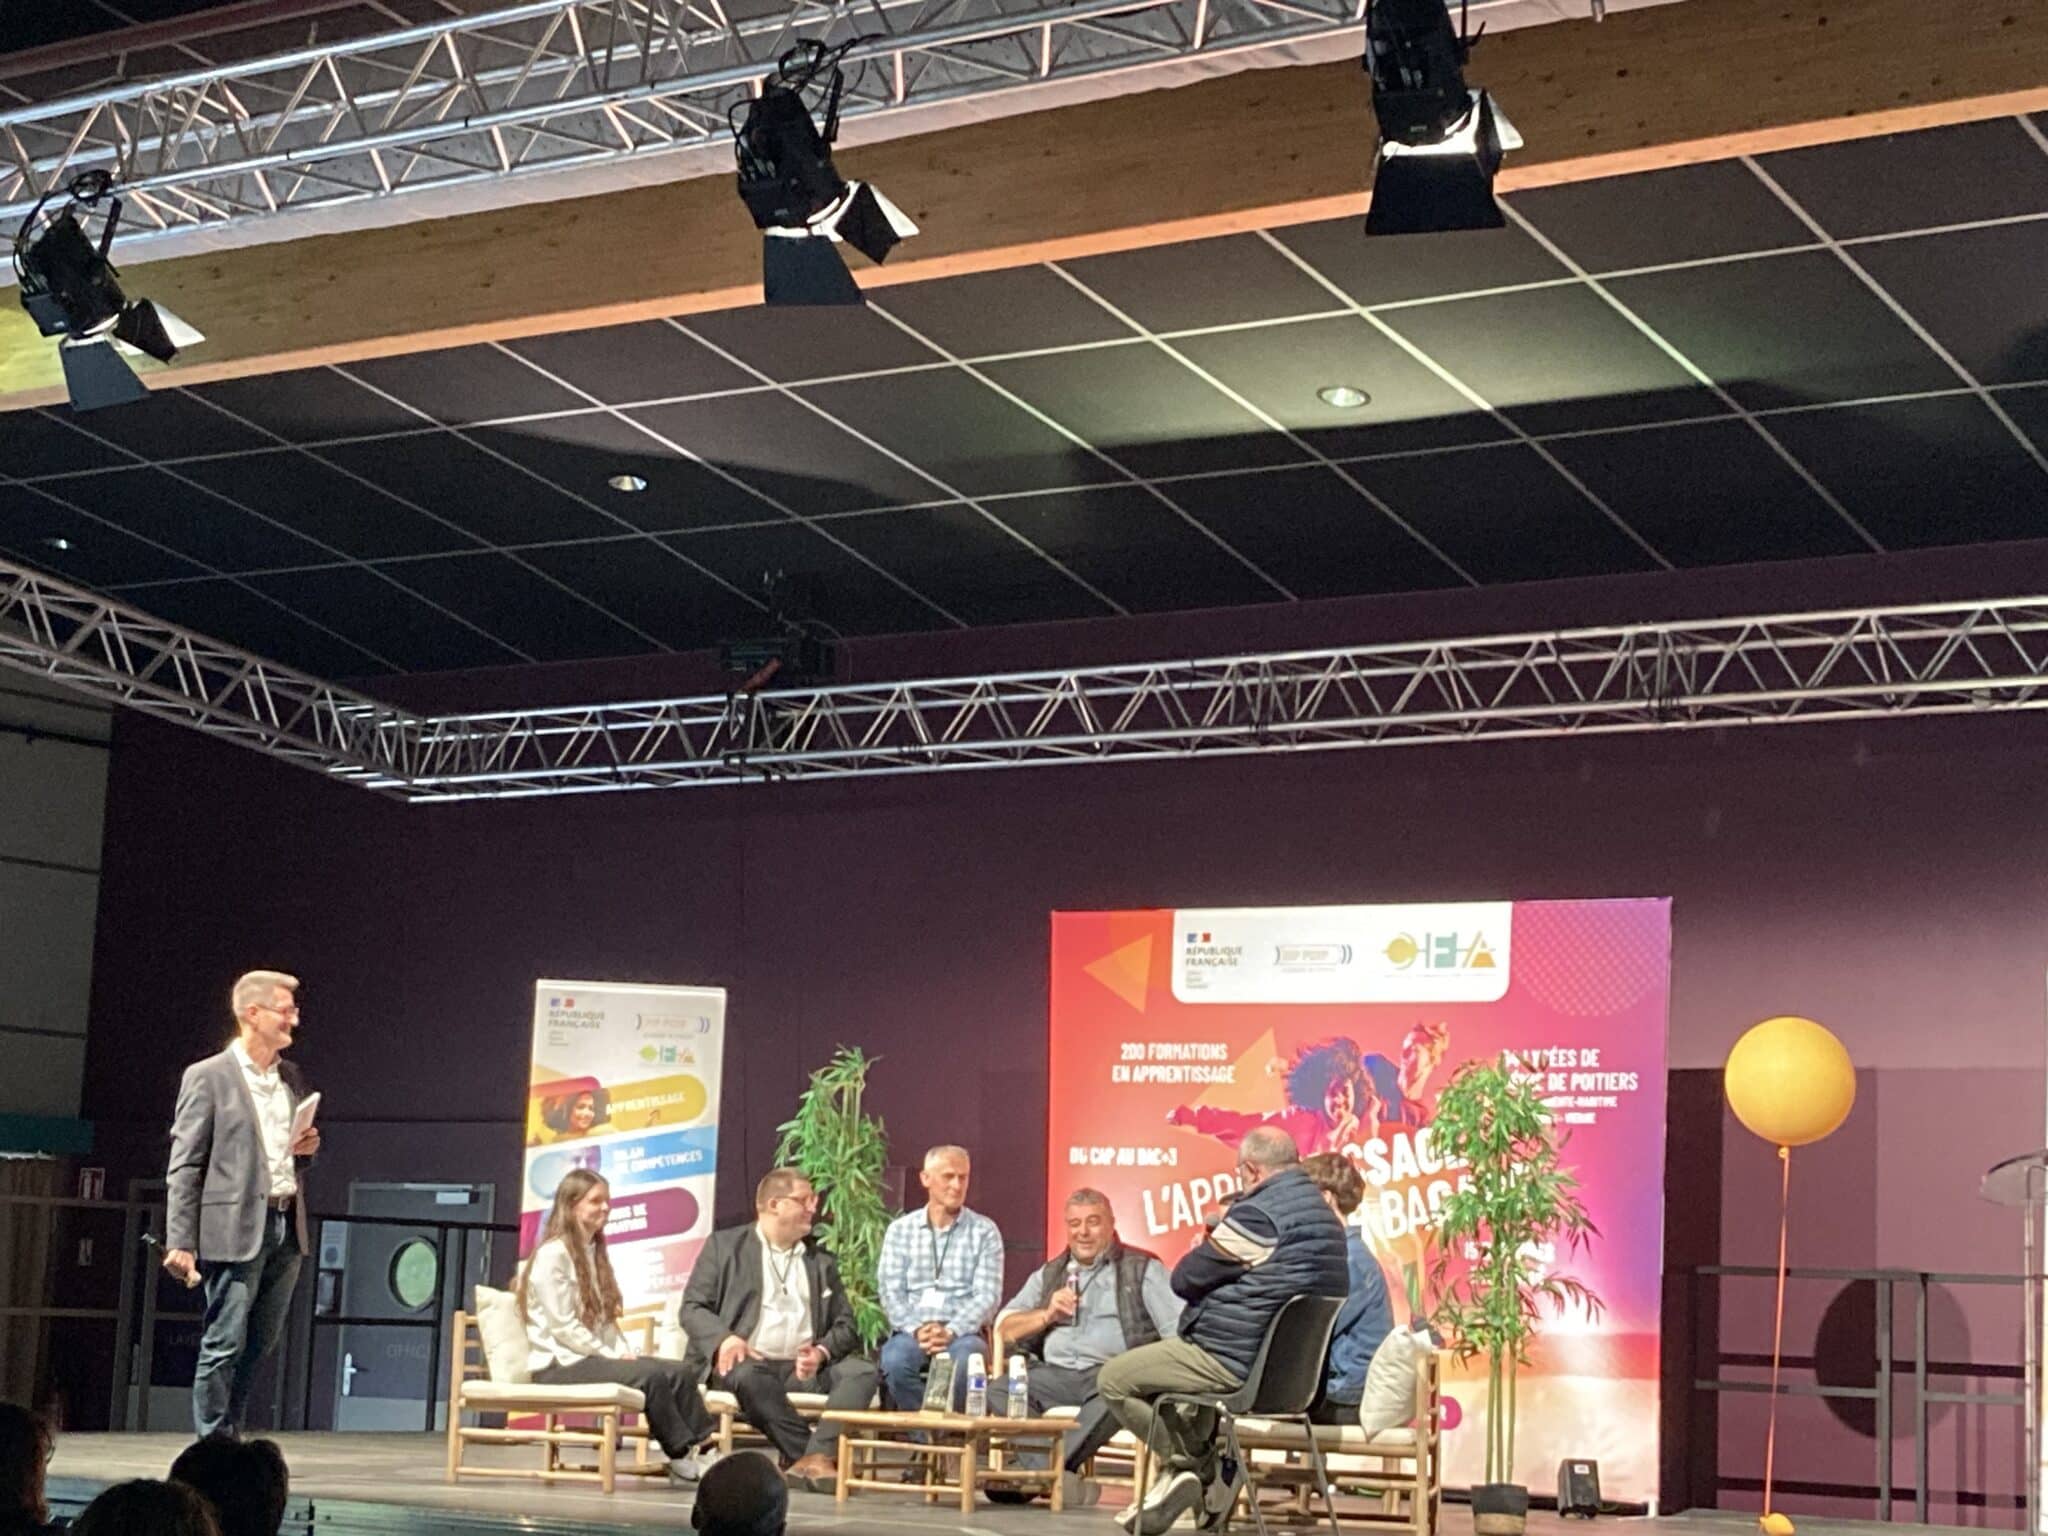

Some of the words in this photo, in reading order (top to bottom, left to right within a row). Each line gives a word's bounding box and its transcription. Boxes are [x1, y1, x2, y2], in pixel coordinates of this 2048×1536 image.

[1121, 1042, 1145, 1060] 200
[1147, 1042, 1228, 1061] FORMATIONS
[1581, 1048, 1600, 1067] DE
[1112, 1064, 1131, 1083] EN
[1132, 1064, 1236, 1084] APPRENTISSAGE
[1547, 1072, 1568, 1092] DE
[1570, 1071, 1639, 1092] POITIERS
